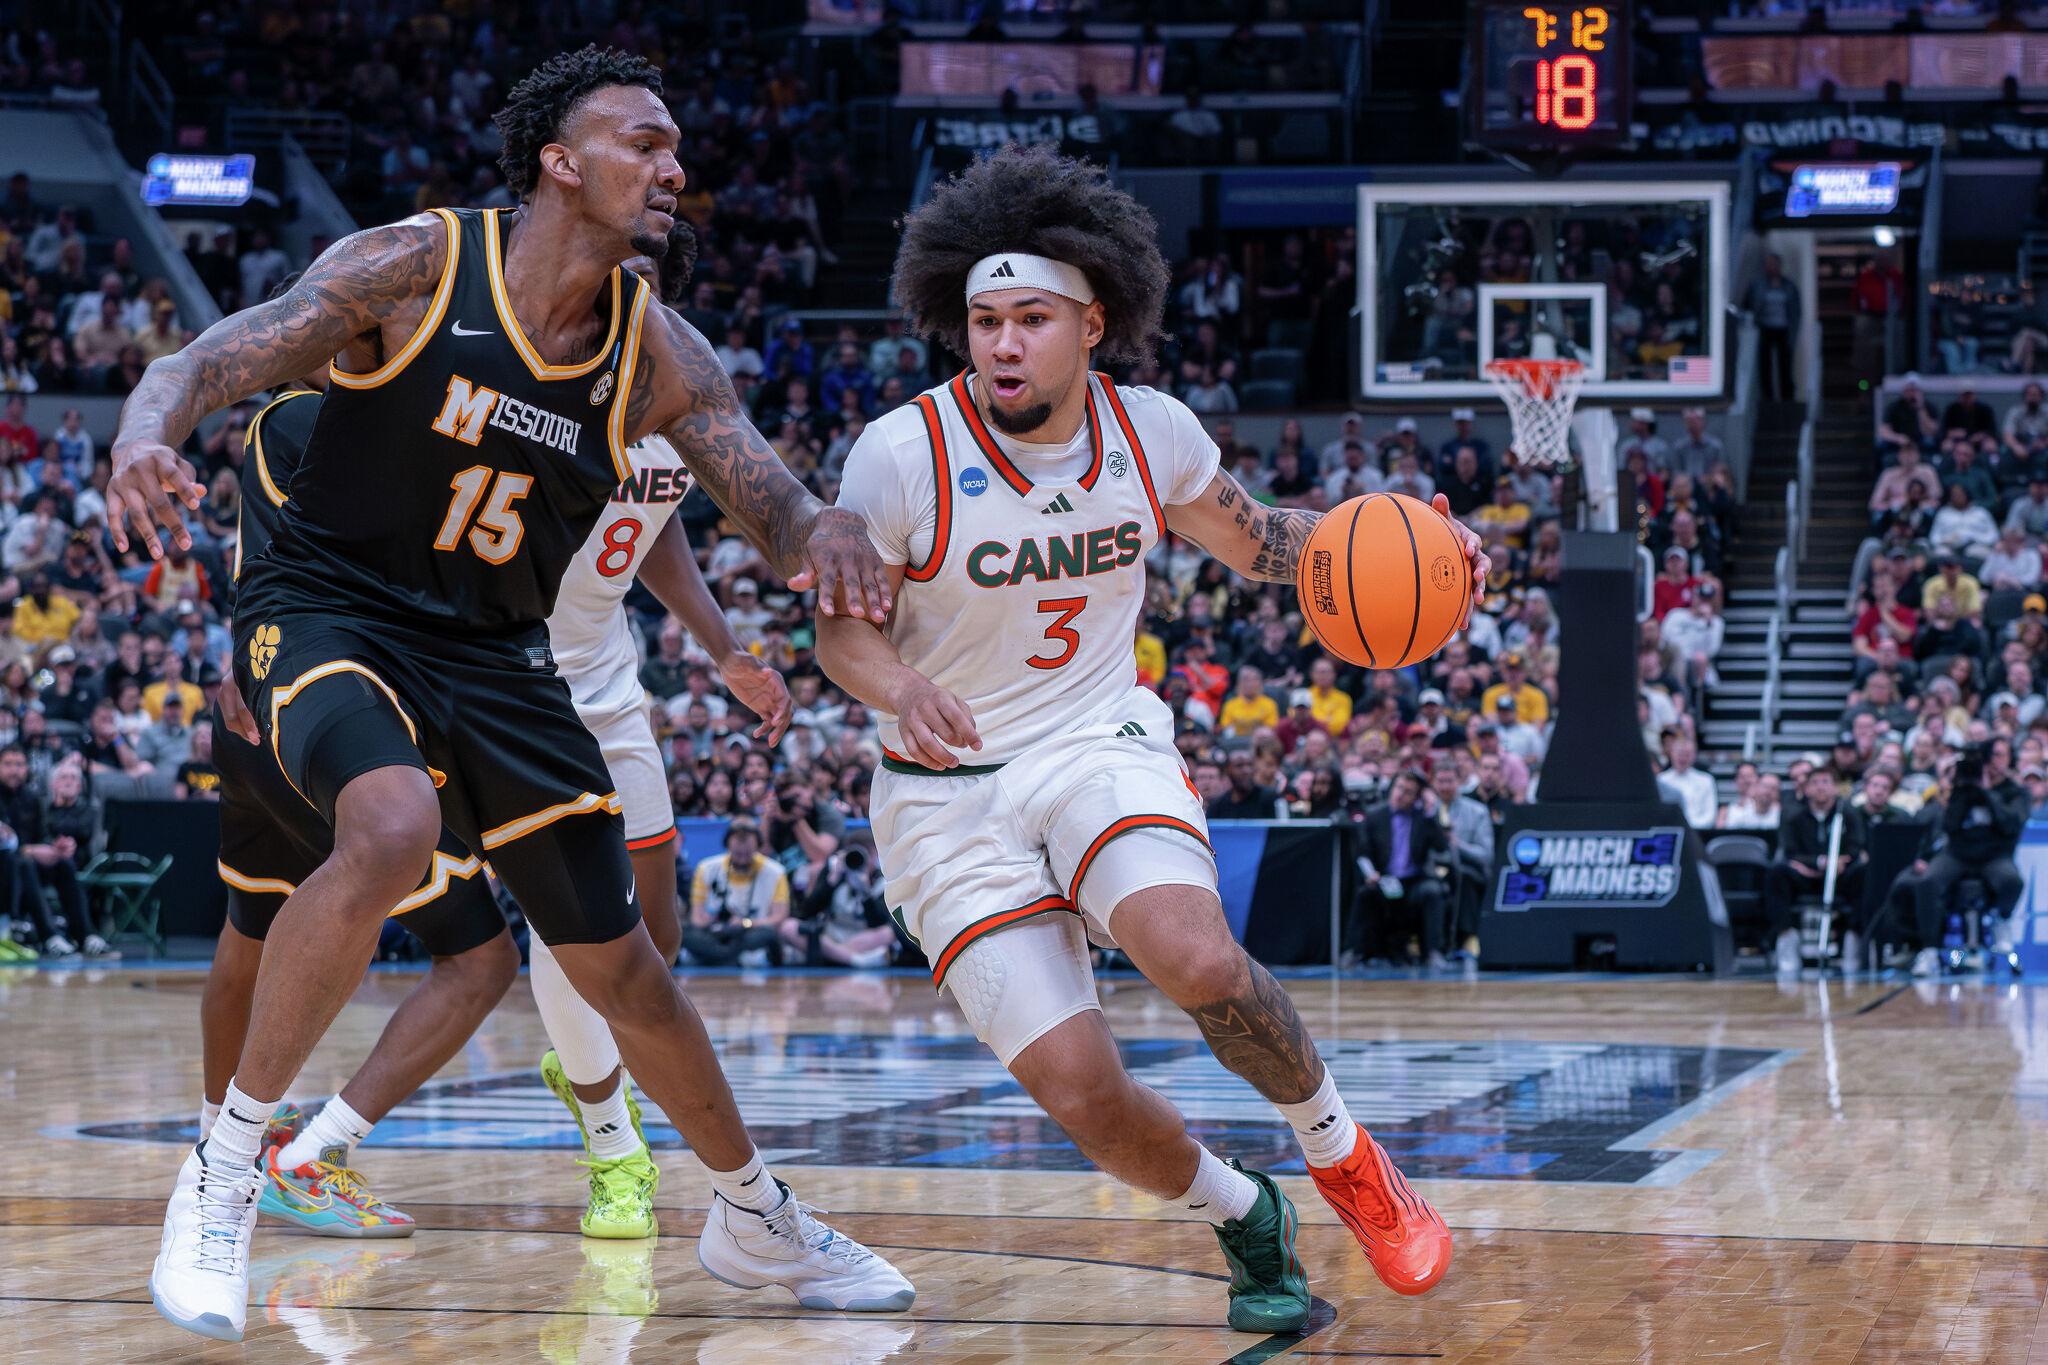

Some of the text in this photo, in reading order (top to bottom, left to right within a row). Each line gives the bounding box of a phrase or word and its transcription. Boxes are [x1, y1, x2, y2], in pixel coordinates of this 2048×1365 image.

[1523, 7, 1609, 51] 7:12
[1536, 54, 1596, 129] 18
[431, 374, 582, 456] MISSOURI
[963, 479, 987, 489] NCAA
[1110, 457, 1126, 468] ACC
[433, 465, 535, 566] 15
[596, 517, 643, 578] 8
[966, 521, 1142, 588] CANES
[1313, 567, 1323, 602] MARCH
[1320, 551, 1332, 598] MADNESS
[1025, 595, 1088, 670] 3
[1539, 837, 1634, 867] MARCH
[1550, 864, 1675, 895] MADNESS
